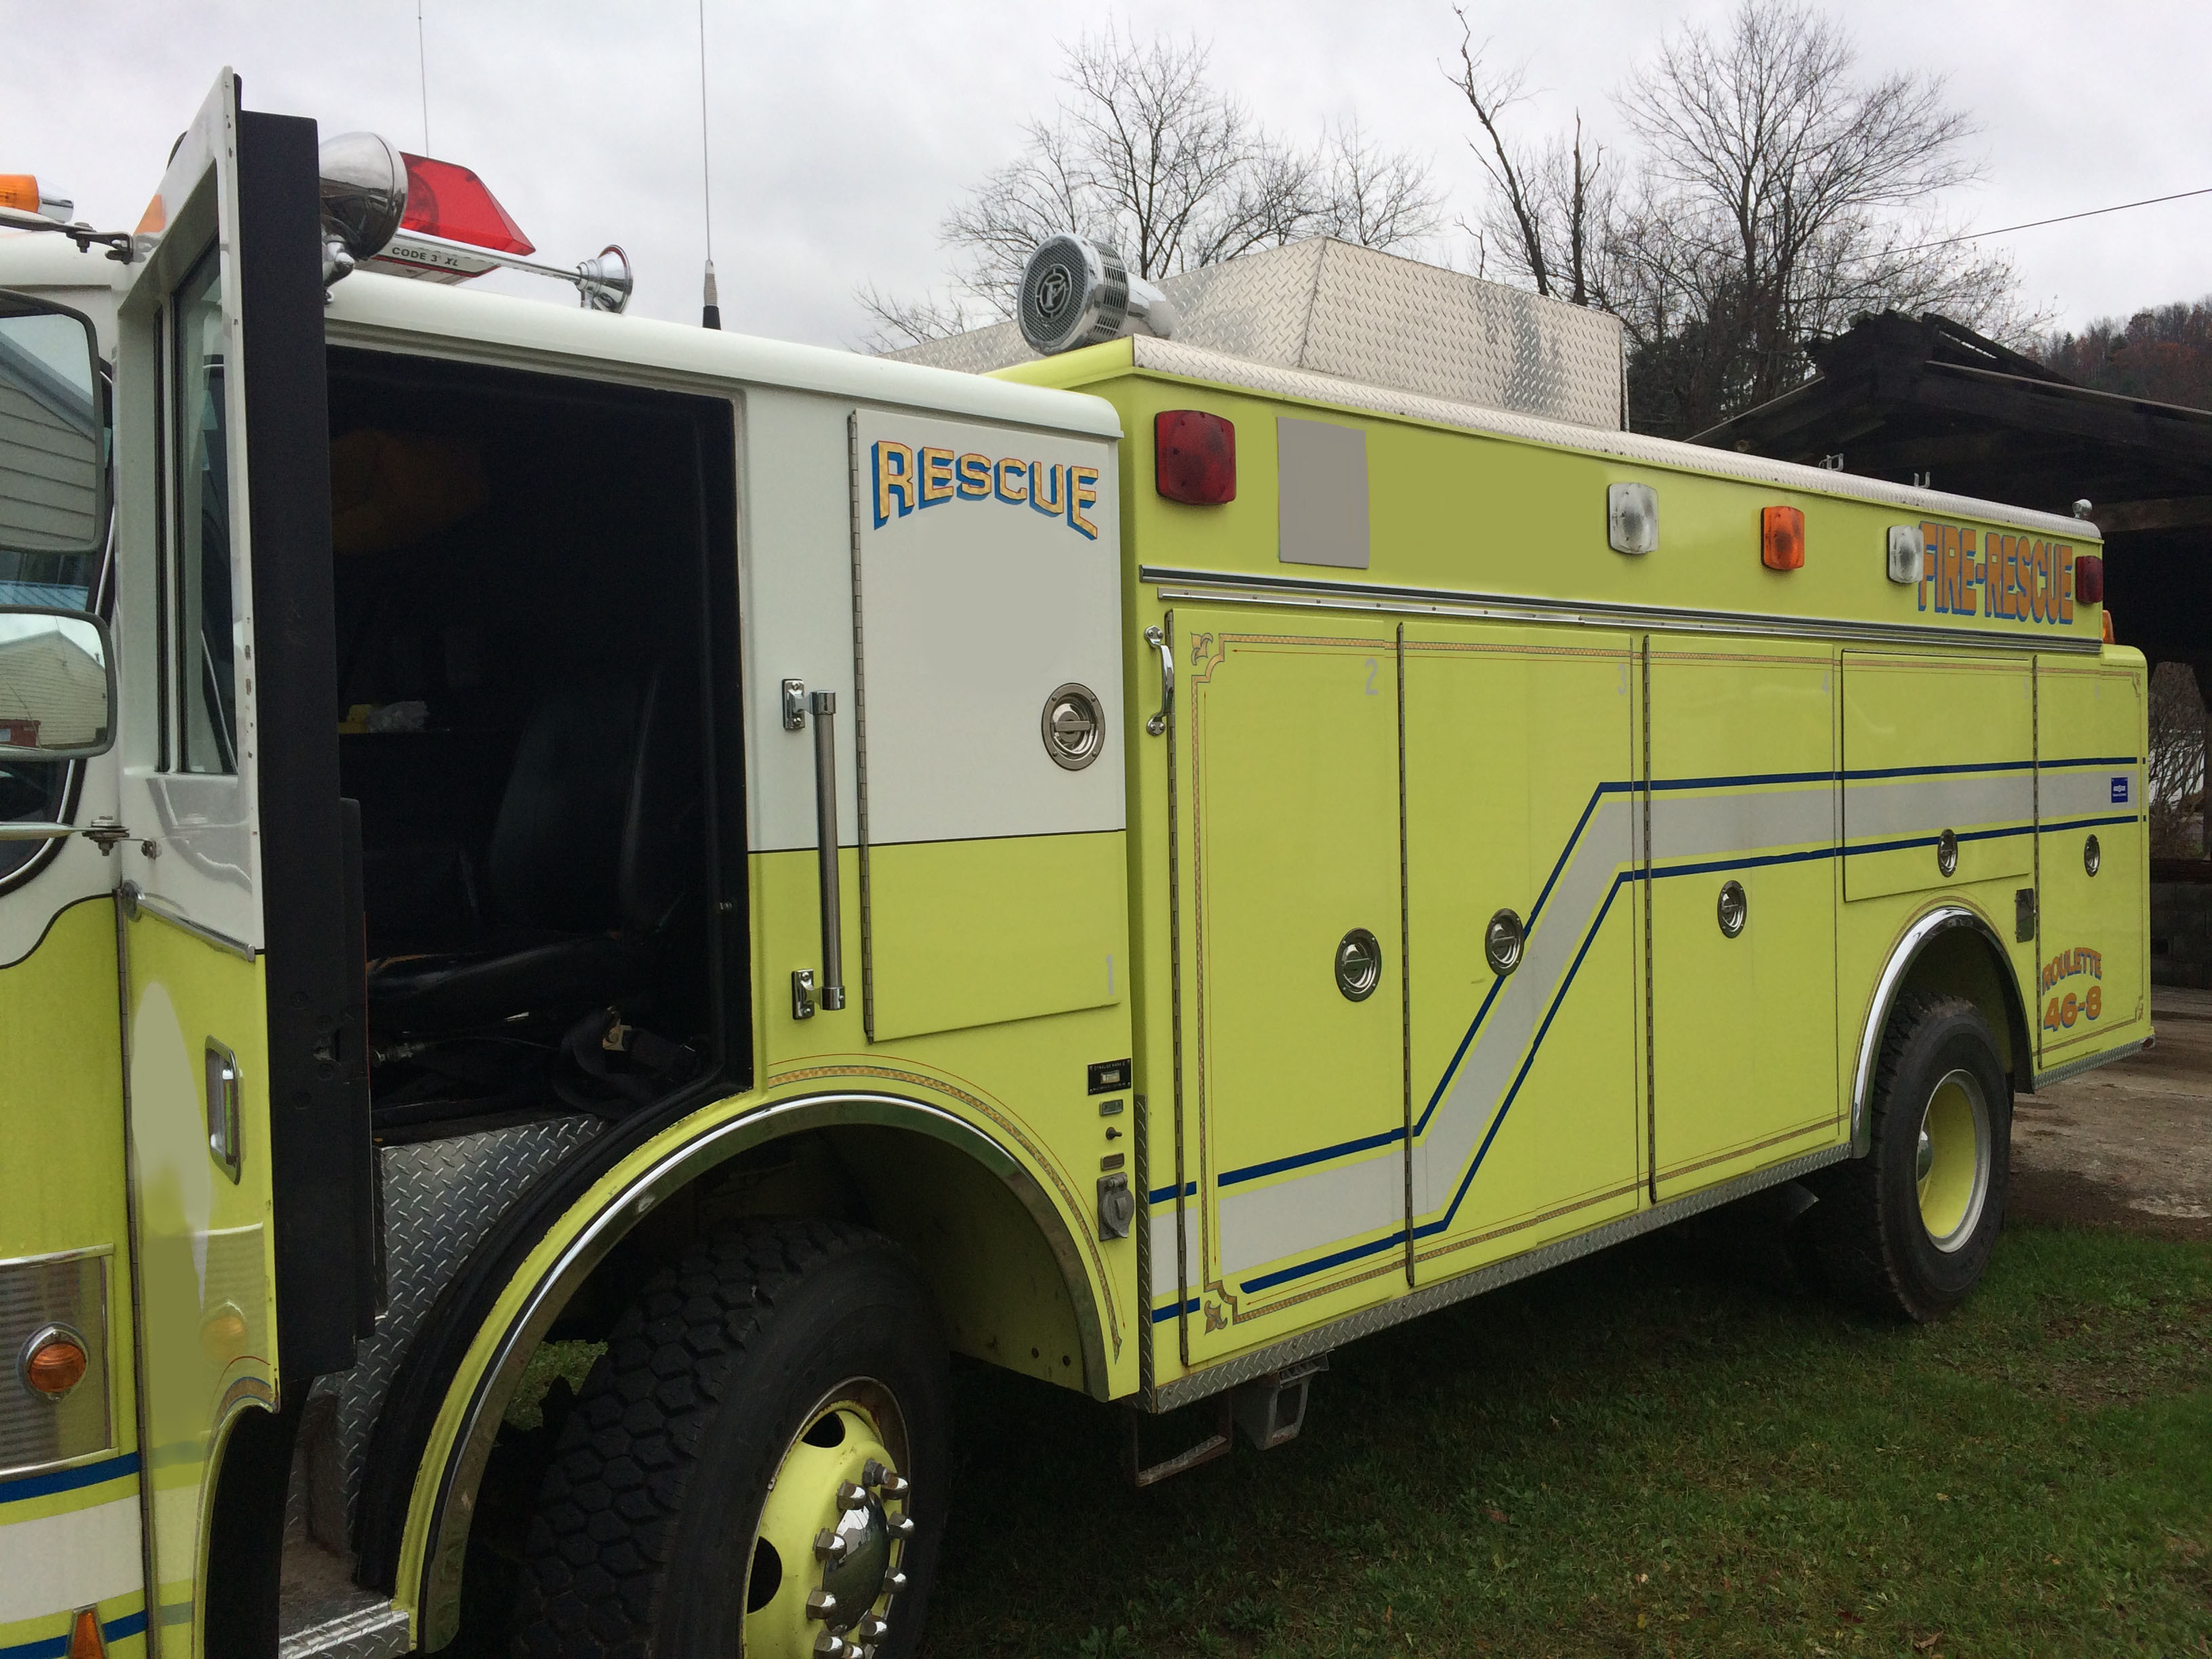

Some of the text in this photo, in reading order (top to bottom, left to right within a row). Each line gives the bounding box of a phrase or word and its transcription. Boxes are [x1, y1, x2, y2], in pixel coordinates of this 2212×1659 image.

[392, 247, 458, 266] CODE 3 XL
[871, 441, 1099, 541] RESCUE
[1918, 520, 2073, 625] FIRE-RESCUE
[1364, 657, 1378, 695] 2
[1106, 954, 1113, 995] 1
[2043, 947, 2102, 996] ROULETTE
[2043, 986, 2102, 1032] 46-8
